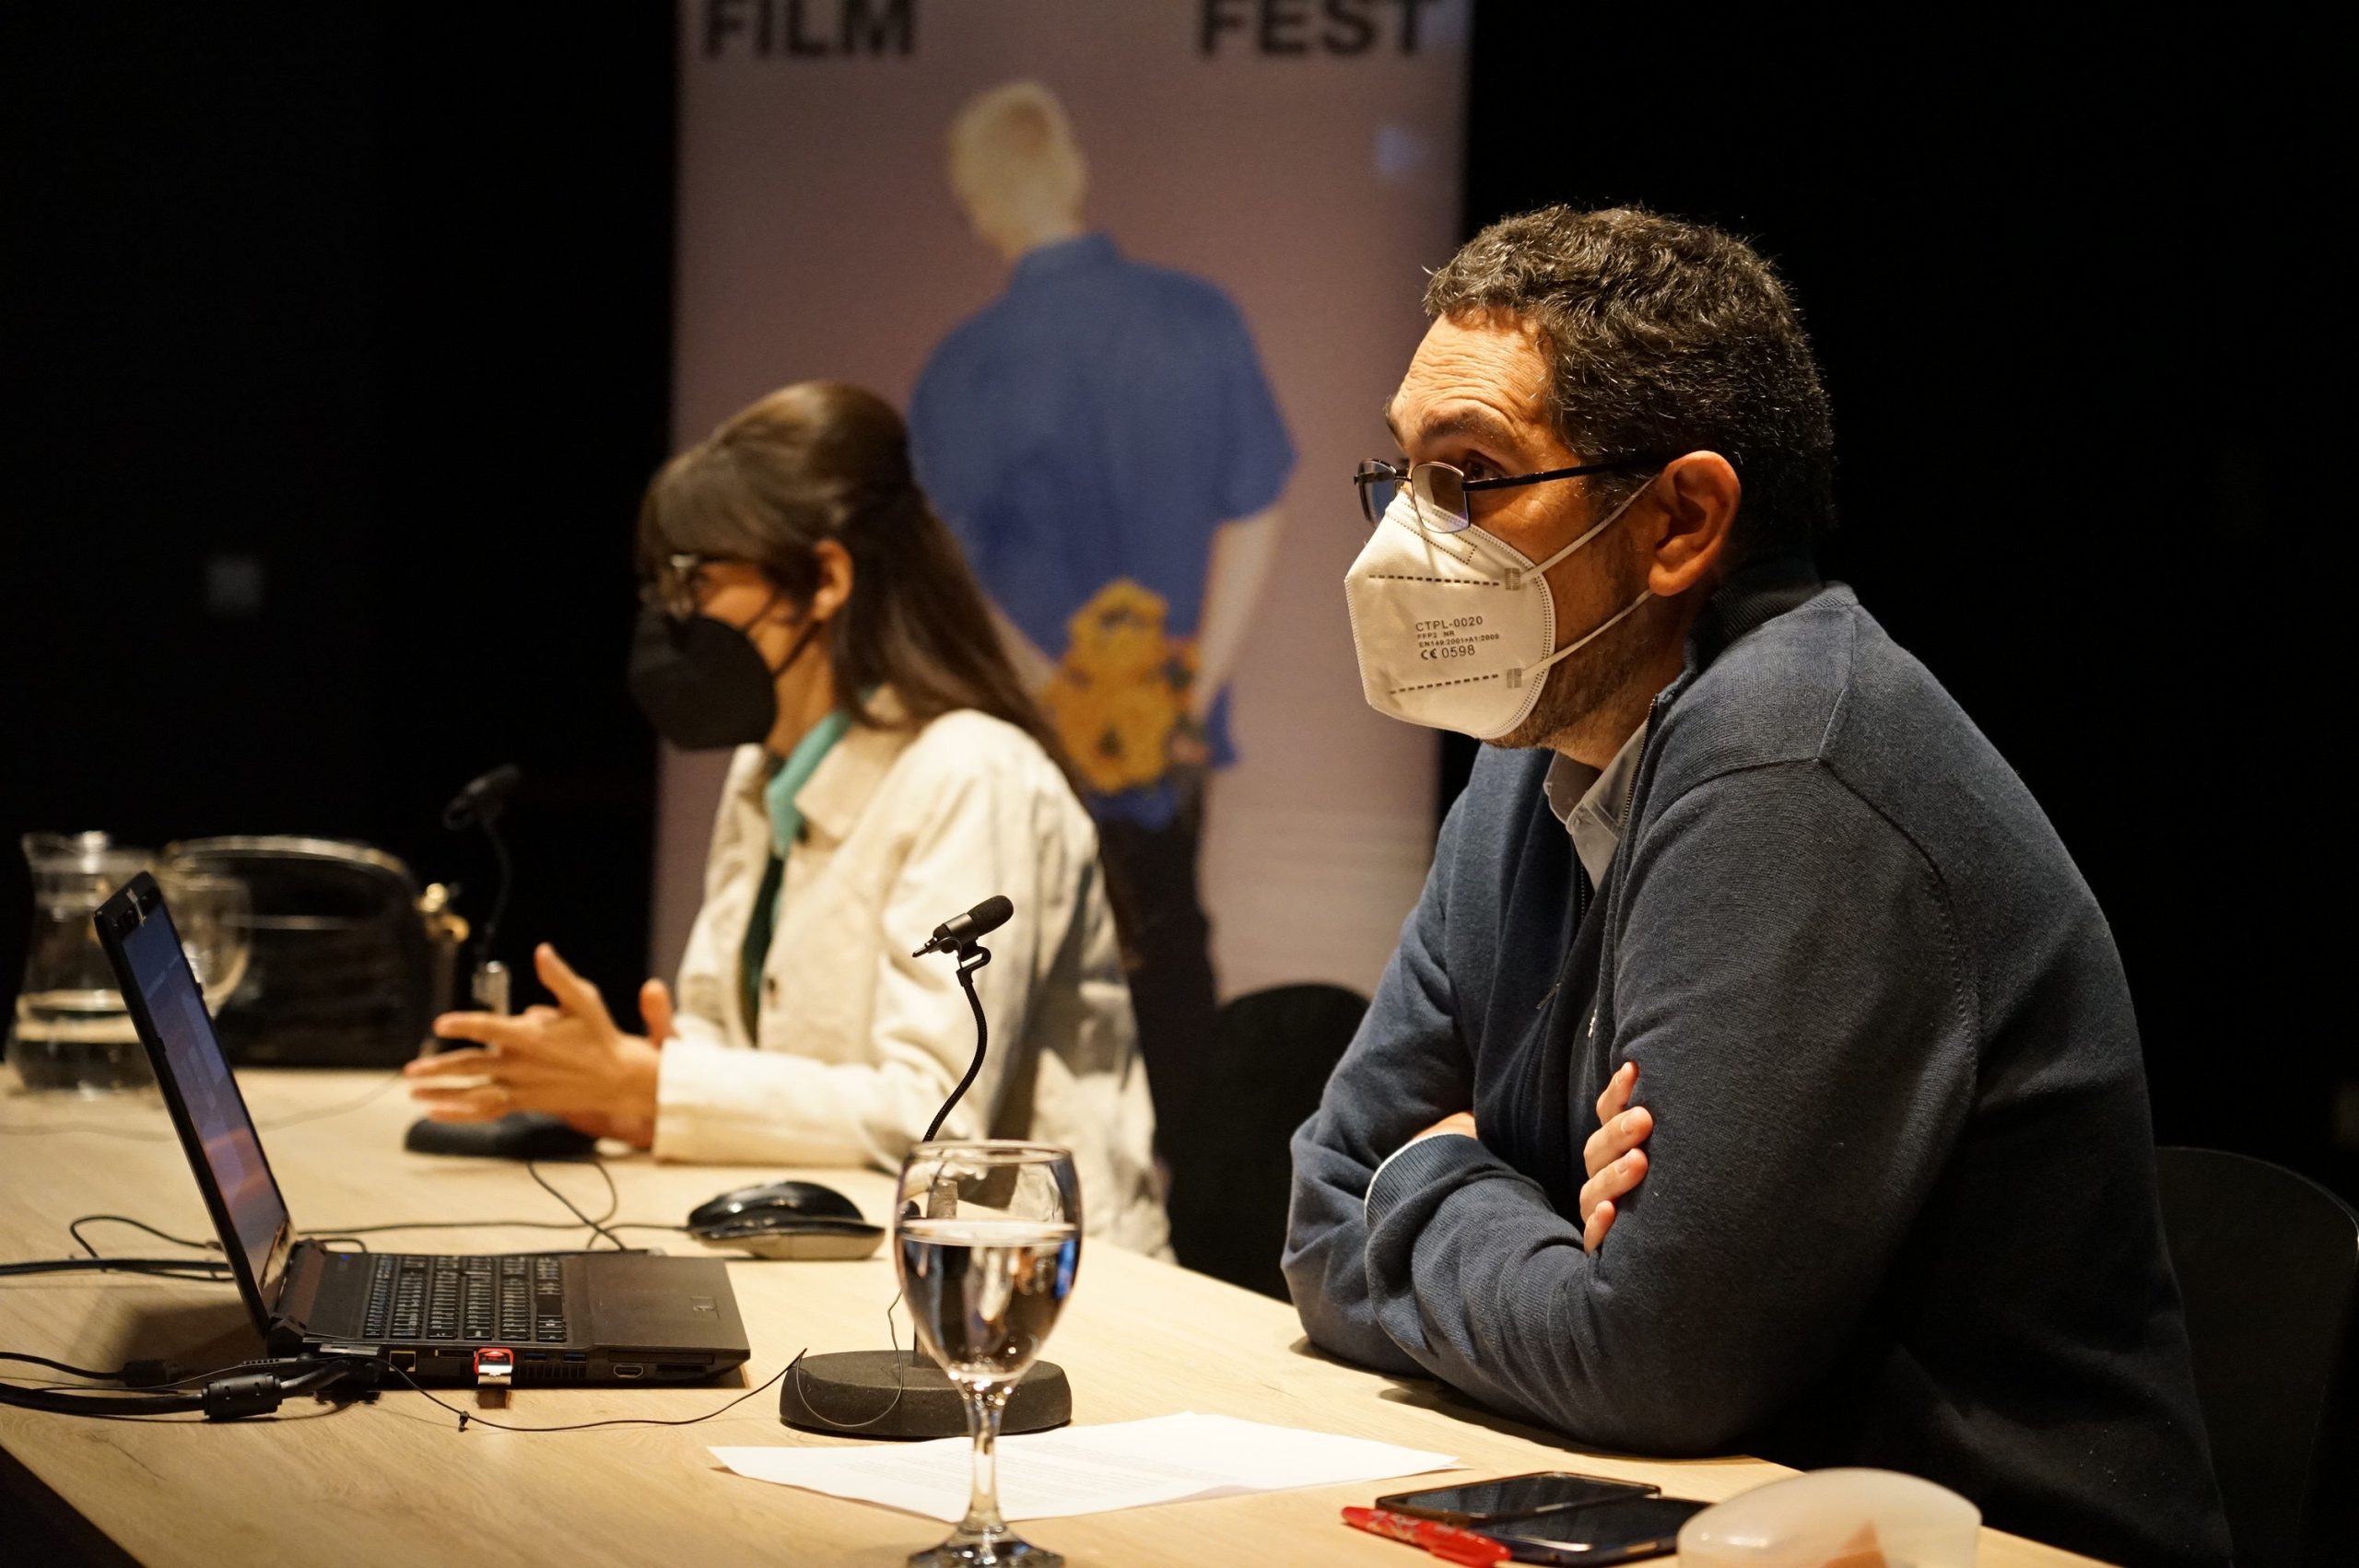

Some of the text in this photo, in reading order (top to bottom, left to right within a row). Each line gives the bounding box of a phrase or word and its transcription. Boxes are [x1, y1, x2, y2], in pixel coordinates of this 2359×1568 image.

[704, 0, 1442, 58] FILM FEST
[1415, 615, 1483, 632] CTPL-0020
[1441, 644, 1475, 659] 0598
